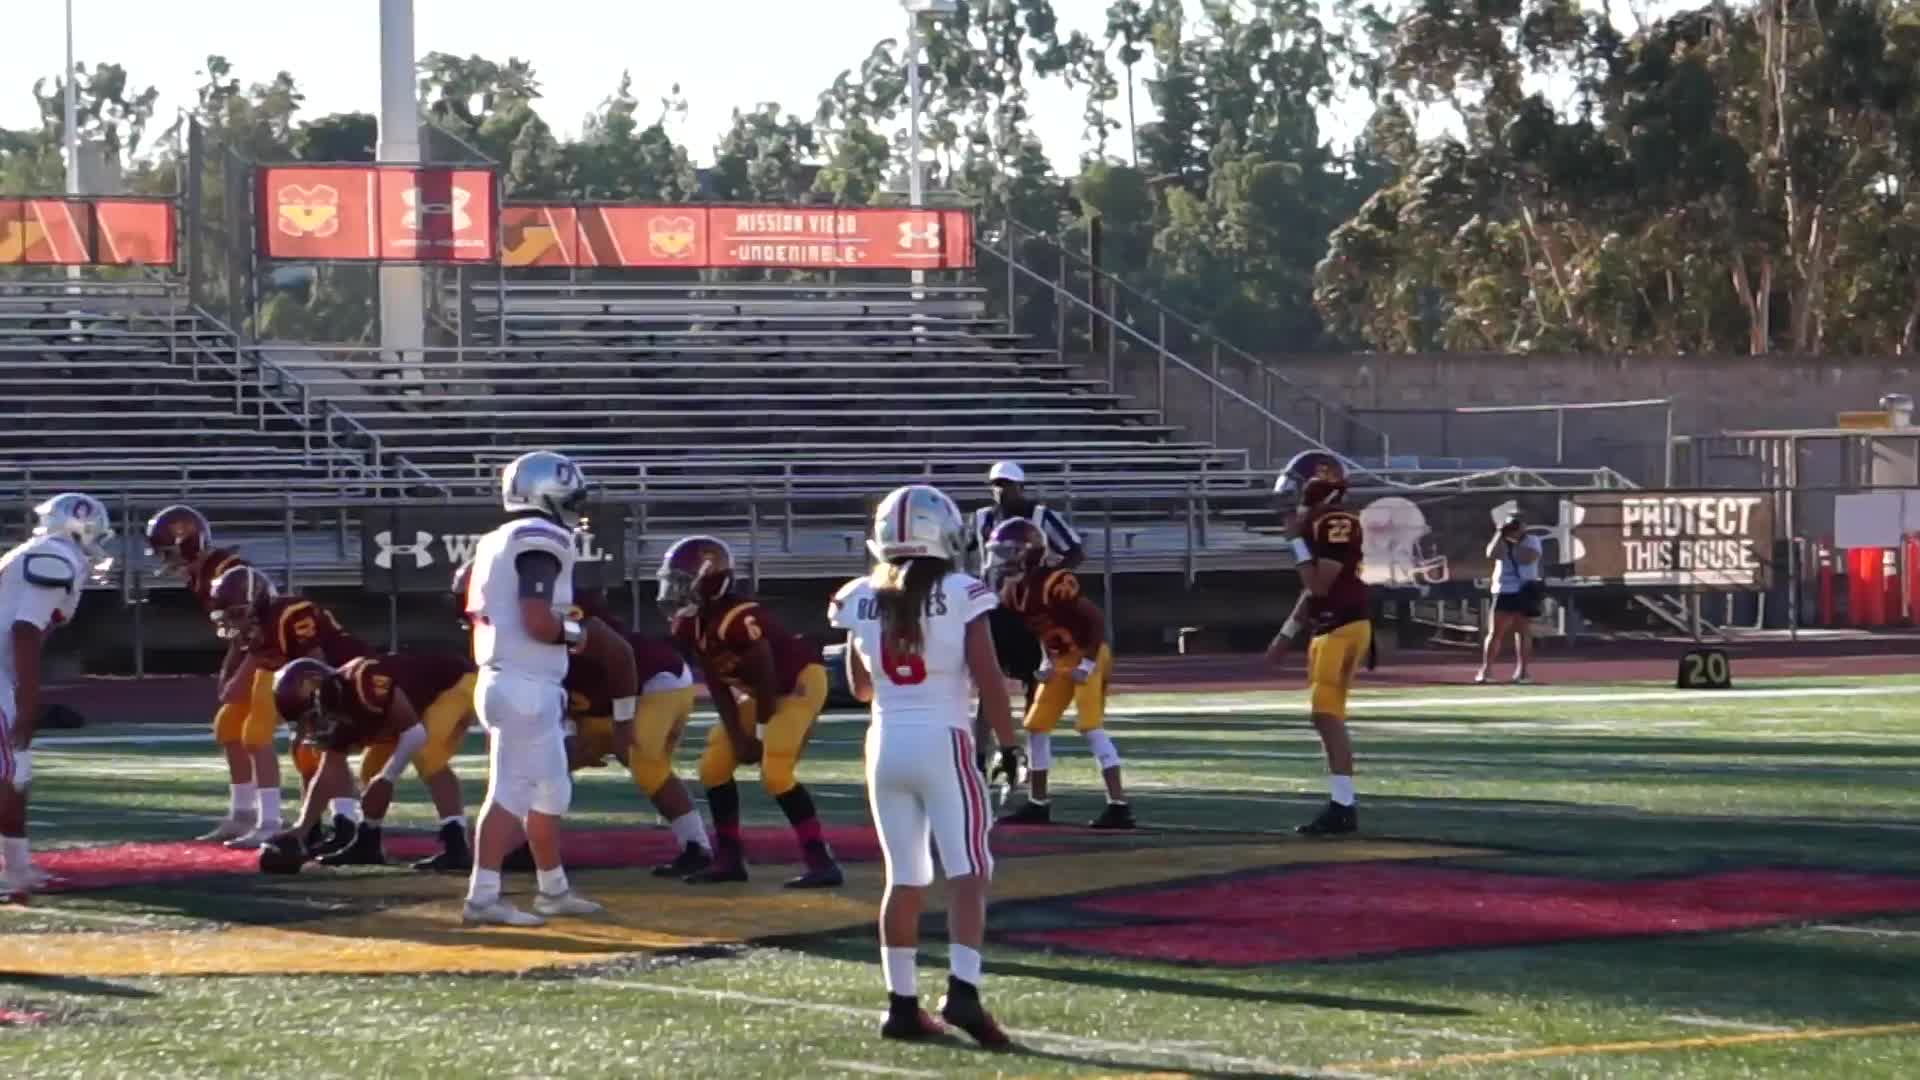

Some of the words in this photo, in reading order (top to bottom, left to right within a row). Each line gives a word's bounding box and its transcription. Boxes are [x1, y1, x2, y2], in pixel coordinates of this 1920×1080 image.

[1327, 518, 1352, 544] 22
[1622, 497, 1762, 537] PROTECT
[1623, 540, 1673, 570] THIS
[743, 615, 763, 641] 6
[1685, 653, 1727, 684] 20
